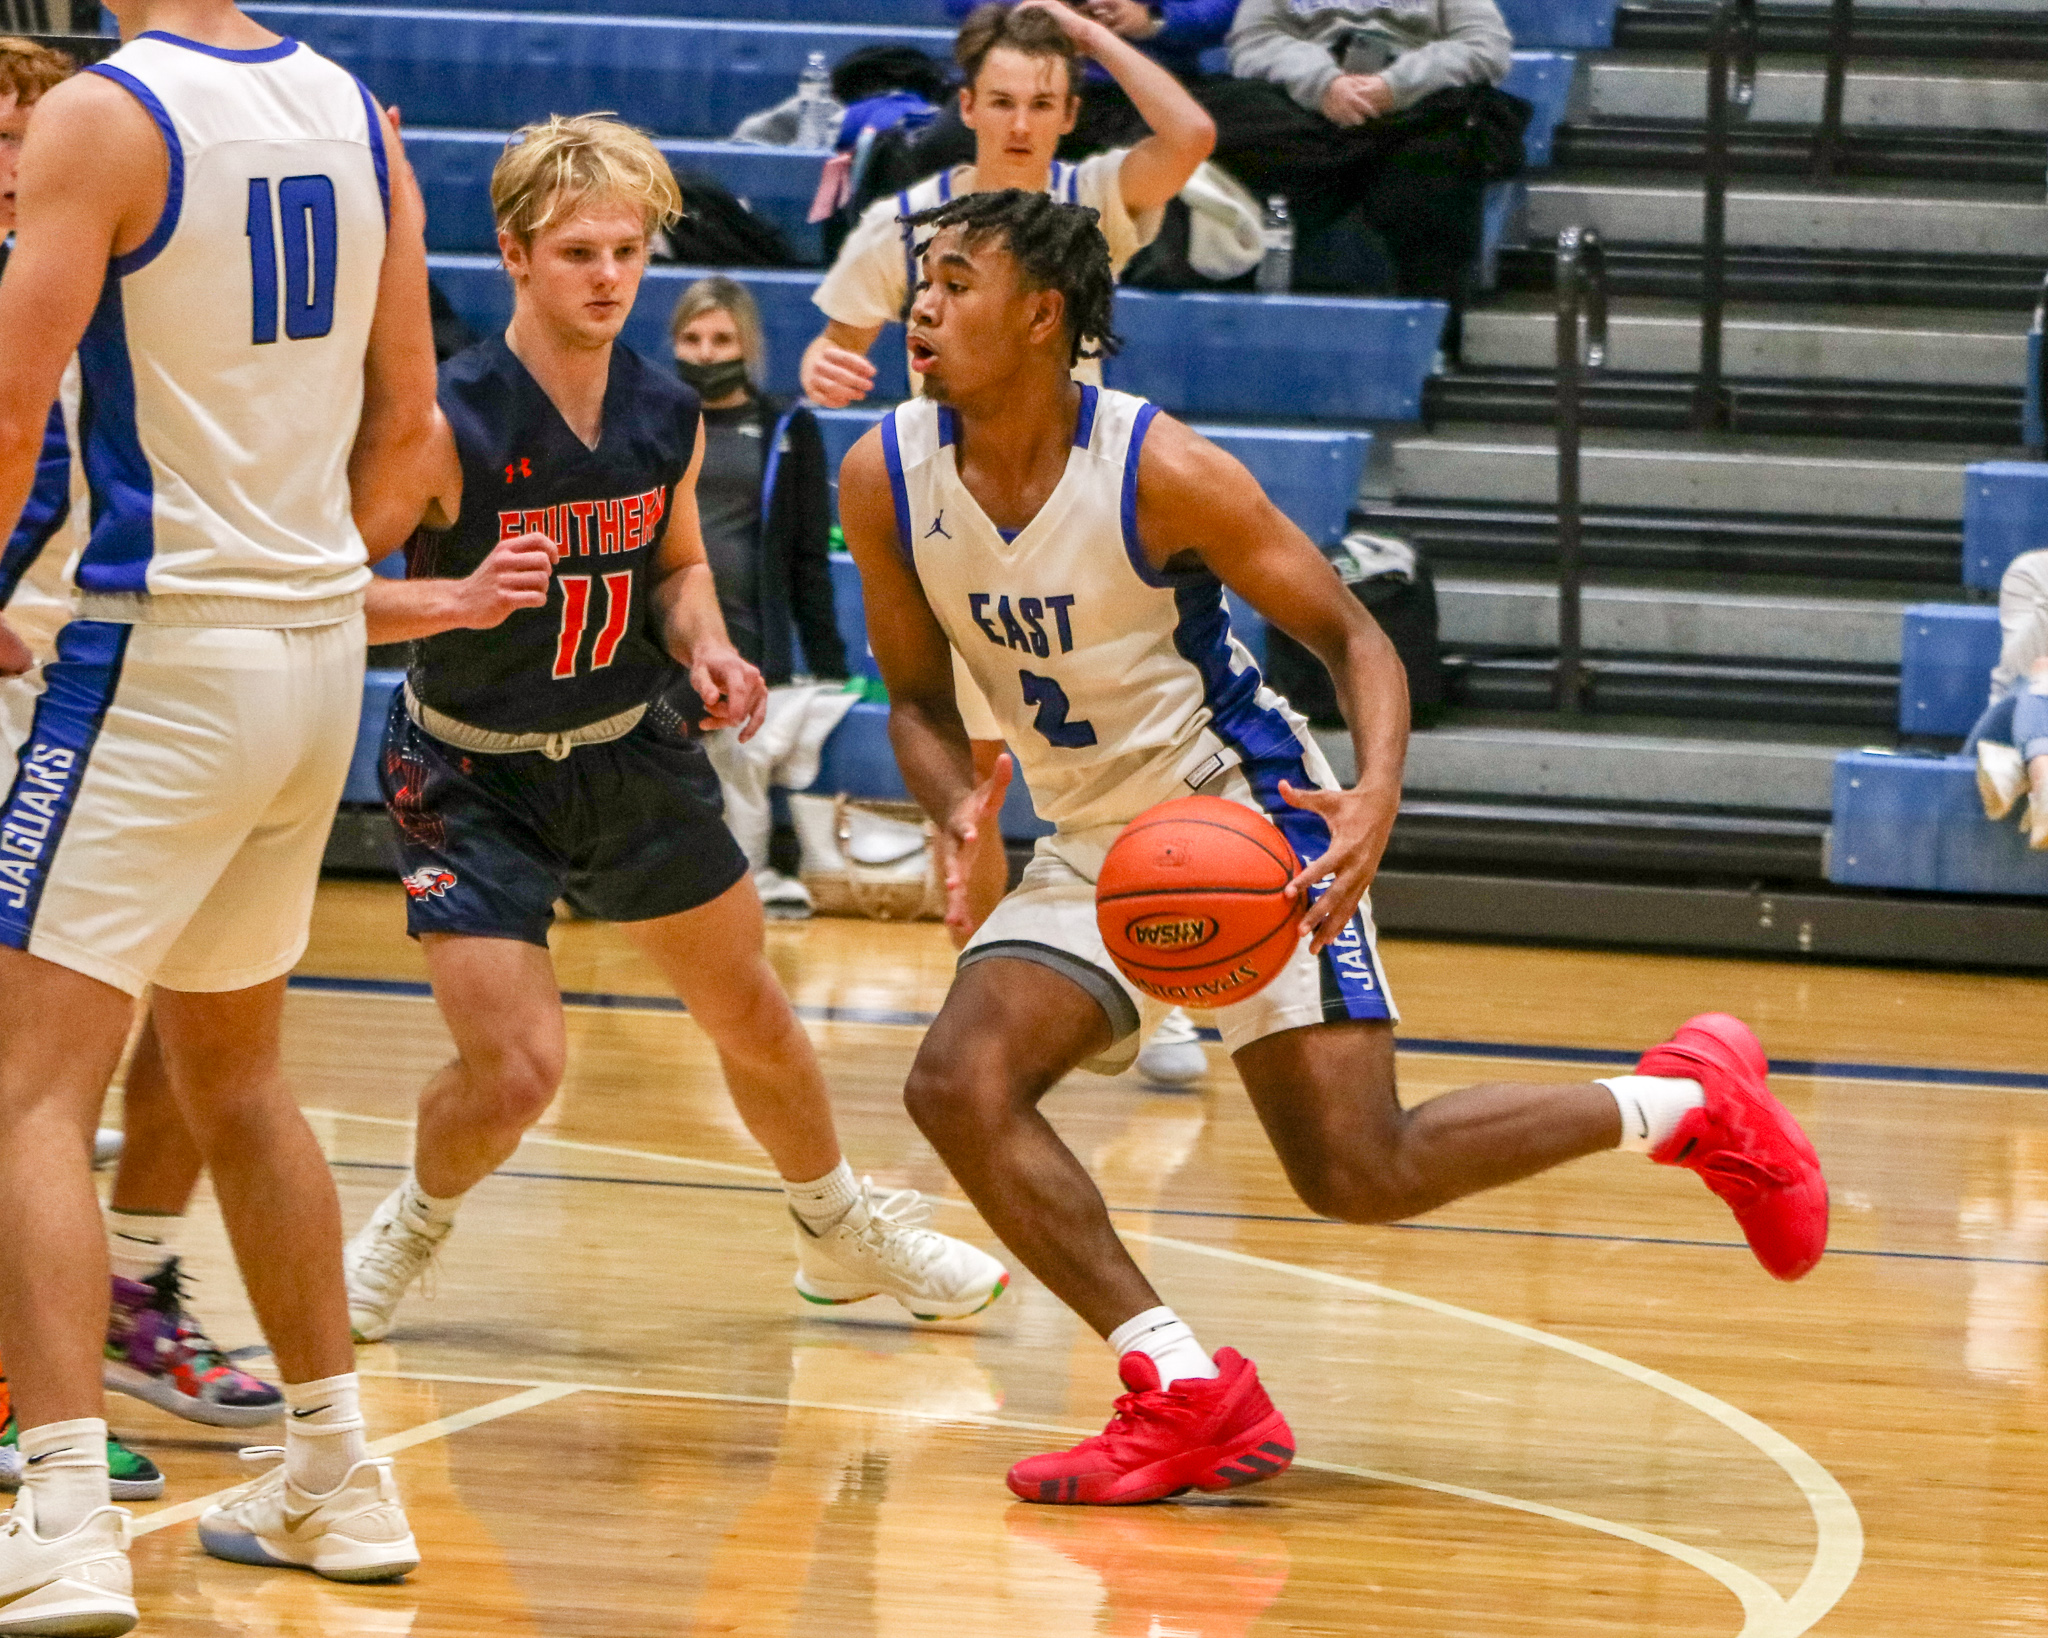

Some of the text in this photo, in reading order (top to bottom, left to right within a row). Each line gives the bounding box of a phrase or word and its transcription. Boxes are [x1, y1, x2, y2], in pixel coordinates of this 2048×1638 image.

[246, 174, 338, 345] 10
[552, 569, 633, 680] 11
[968, 593, 1075, 658] EAST
[1018, 669, 1098, 749] 2
[0, 744, 76, 909] JAGUARS
[1136, 920, 1205, 945] KHSAA
